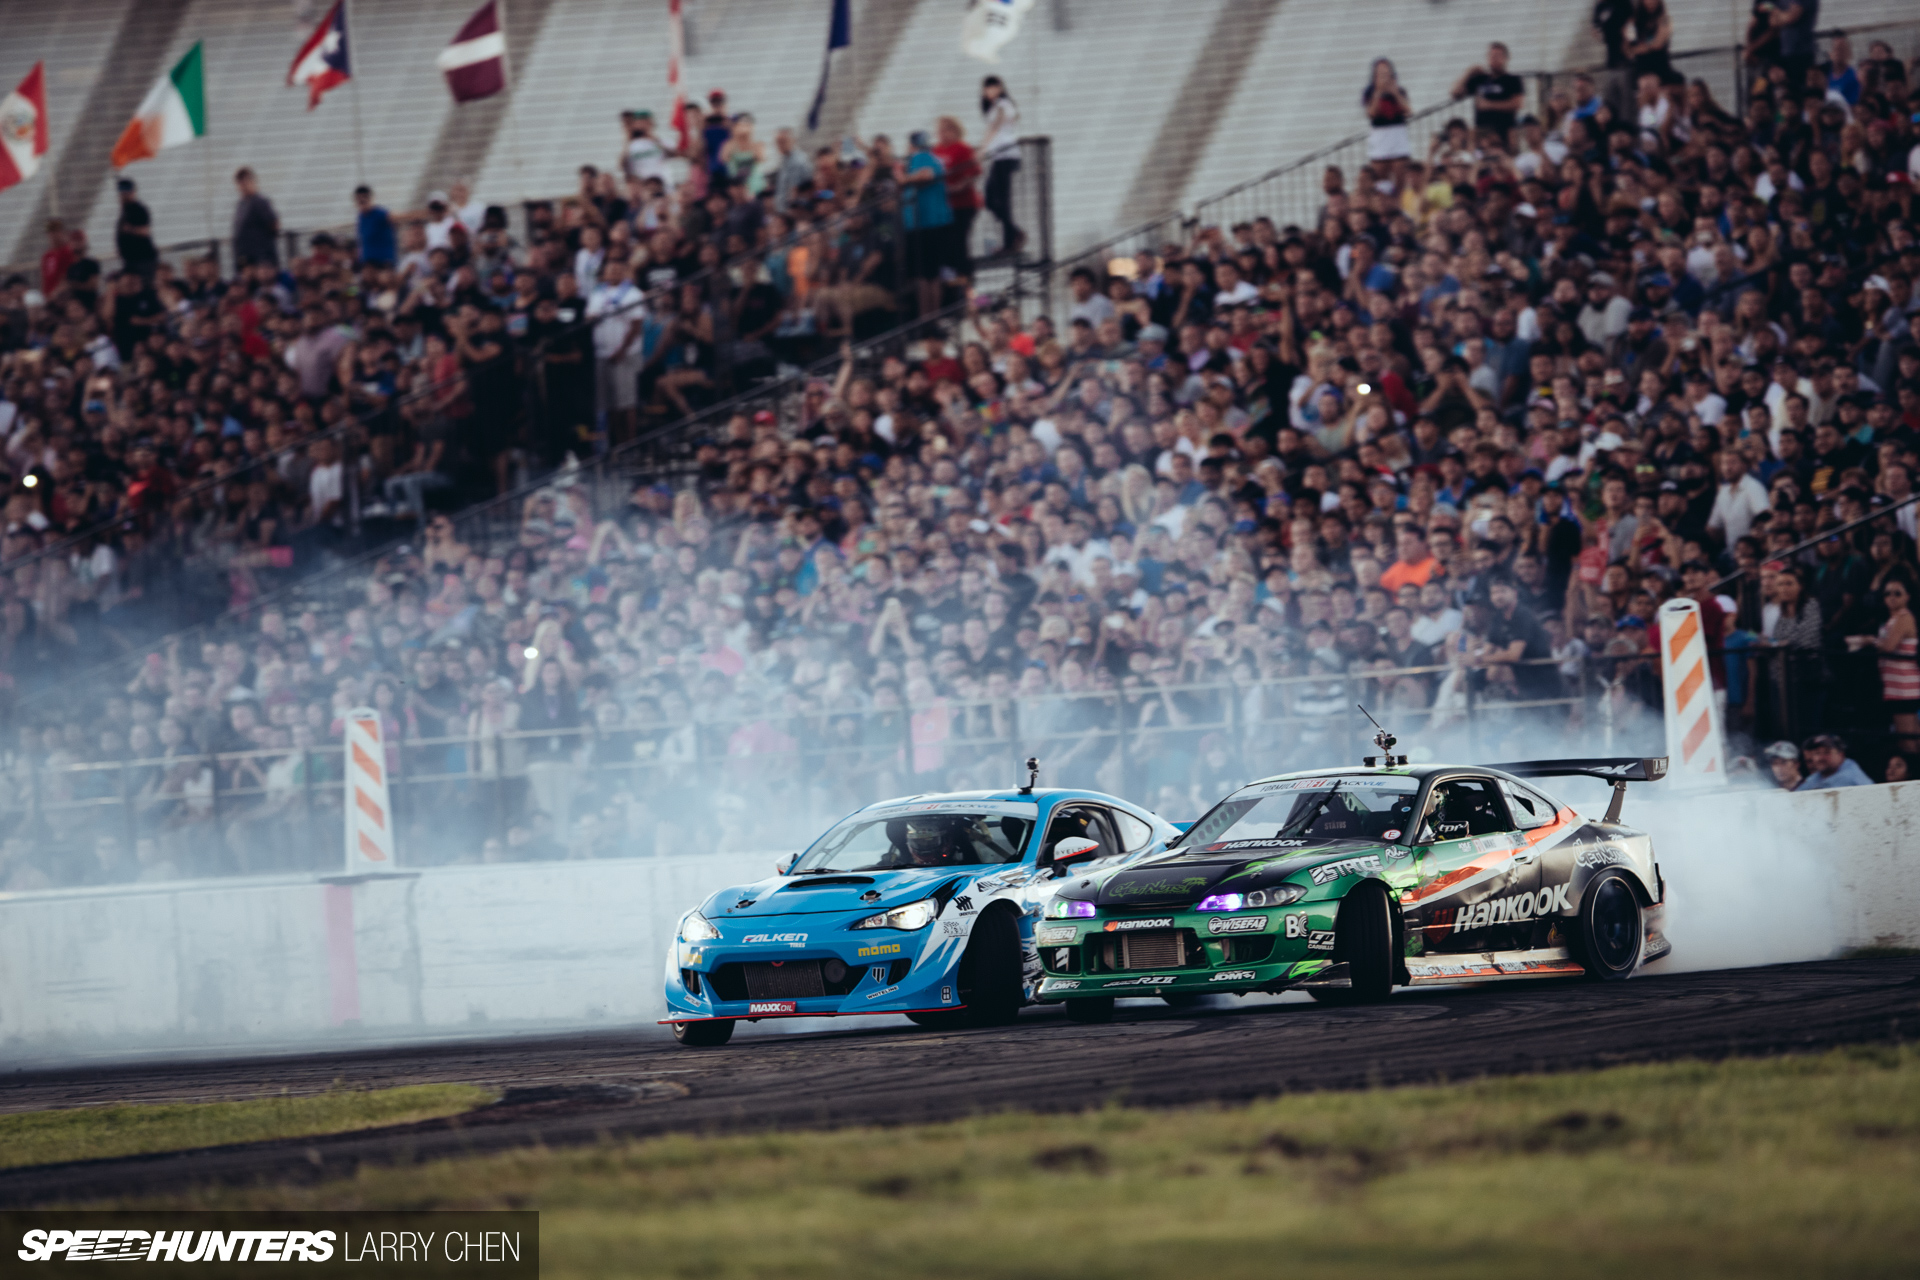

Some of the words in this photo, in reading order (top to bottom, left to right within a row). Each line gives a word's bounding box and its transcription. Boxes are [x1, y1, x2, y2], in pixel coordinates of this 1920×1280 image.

[1260, 783, 1296, 793] FORMULA
[750, 1003, 780, 1013] MAXX
[780, 1004, 794, 1012] OIL
